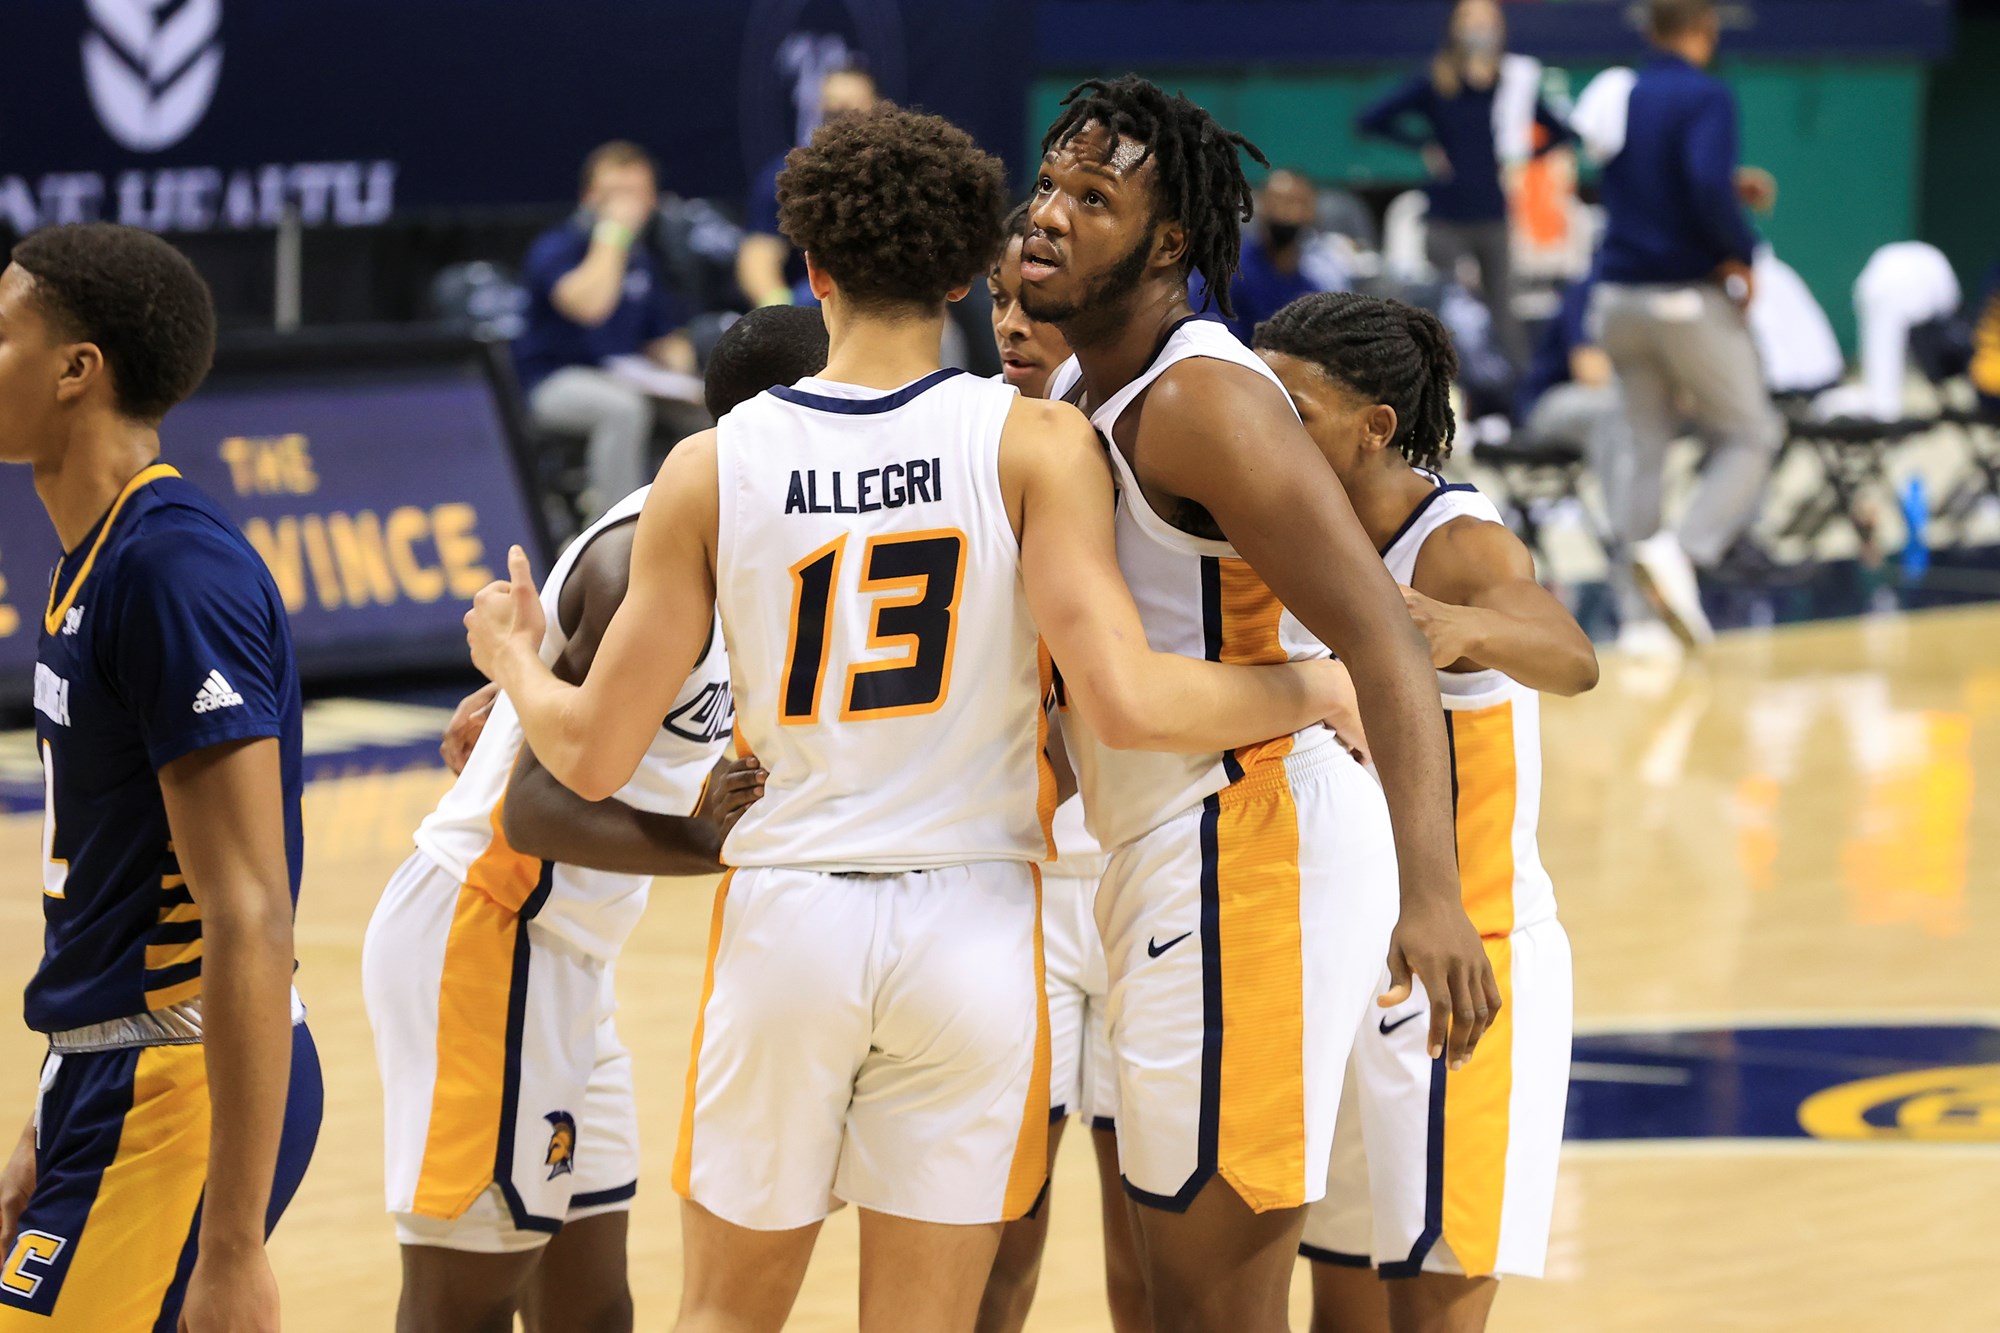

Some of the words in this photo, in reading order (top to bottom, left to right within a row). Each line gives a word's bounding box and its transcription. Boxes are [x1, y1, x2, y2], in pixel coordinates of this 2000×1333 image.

[220, 433, 318, 496] THE
[785, 457, 942, 515] ALLEGRI
[243, 503, 492, 614] VINCE
[778, 527, 968, 726] 13
[192, 692, 244, 714] adidas
[0, 1229, 68, 1299] C
